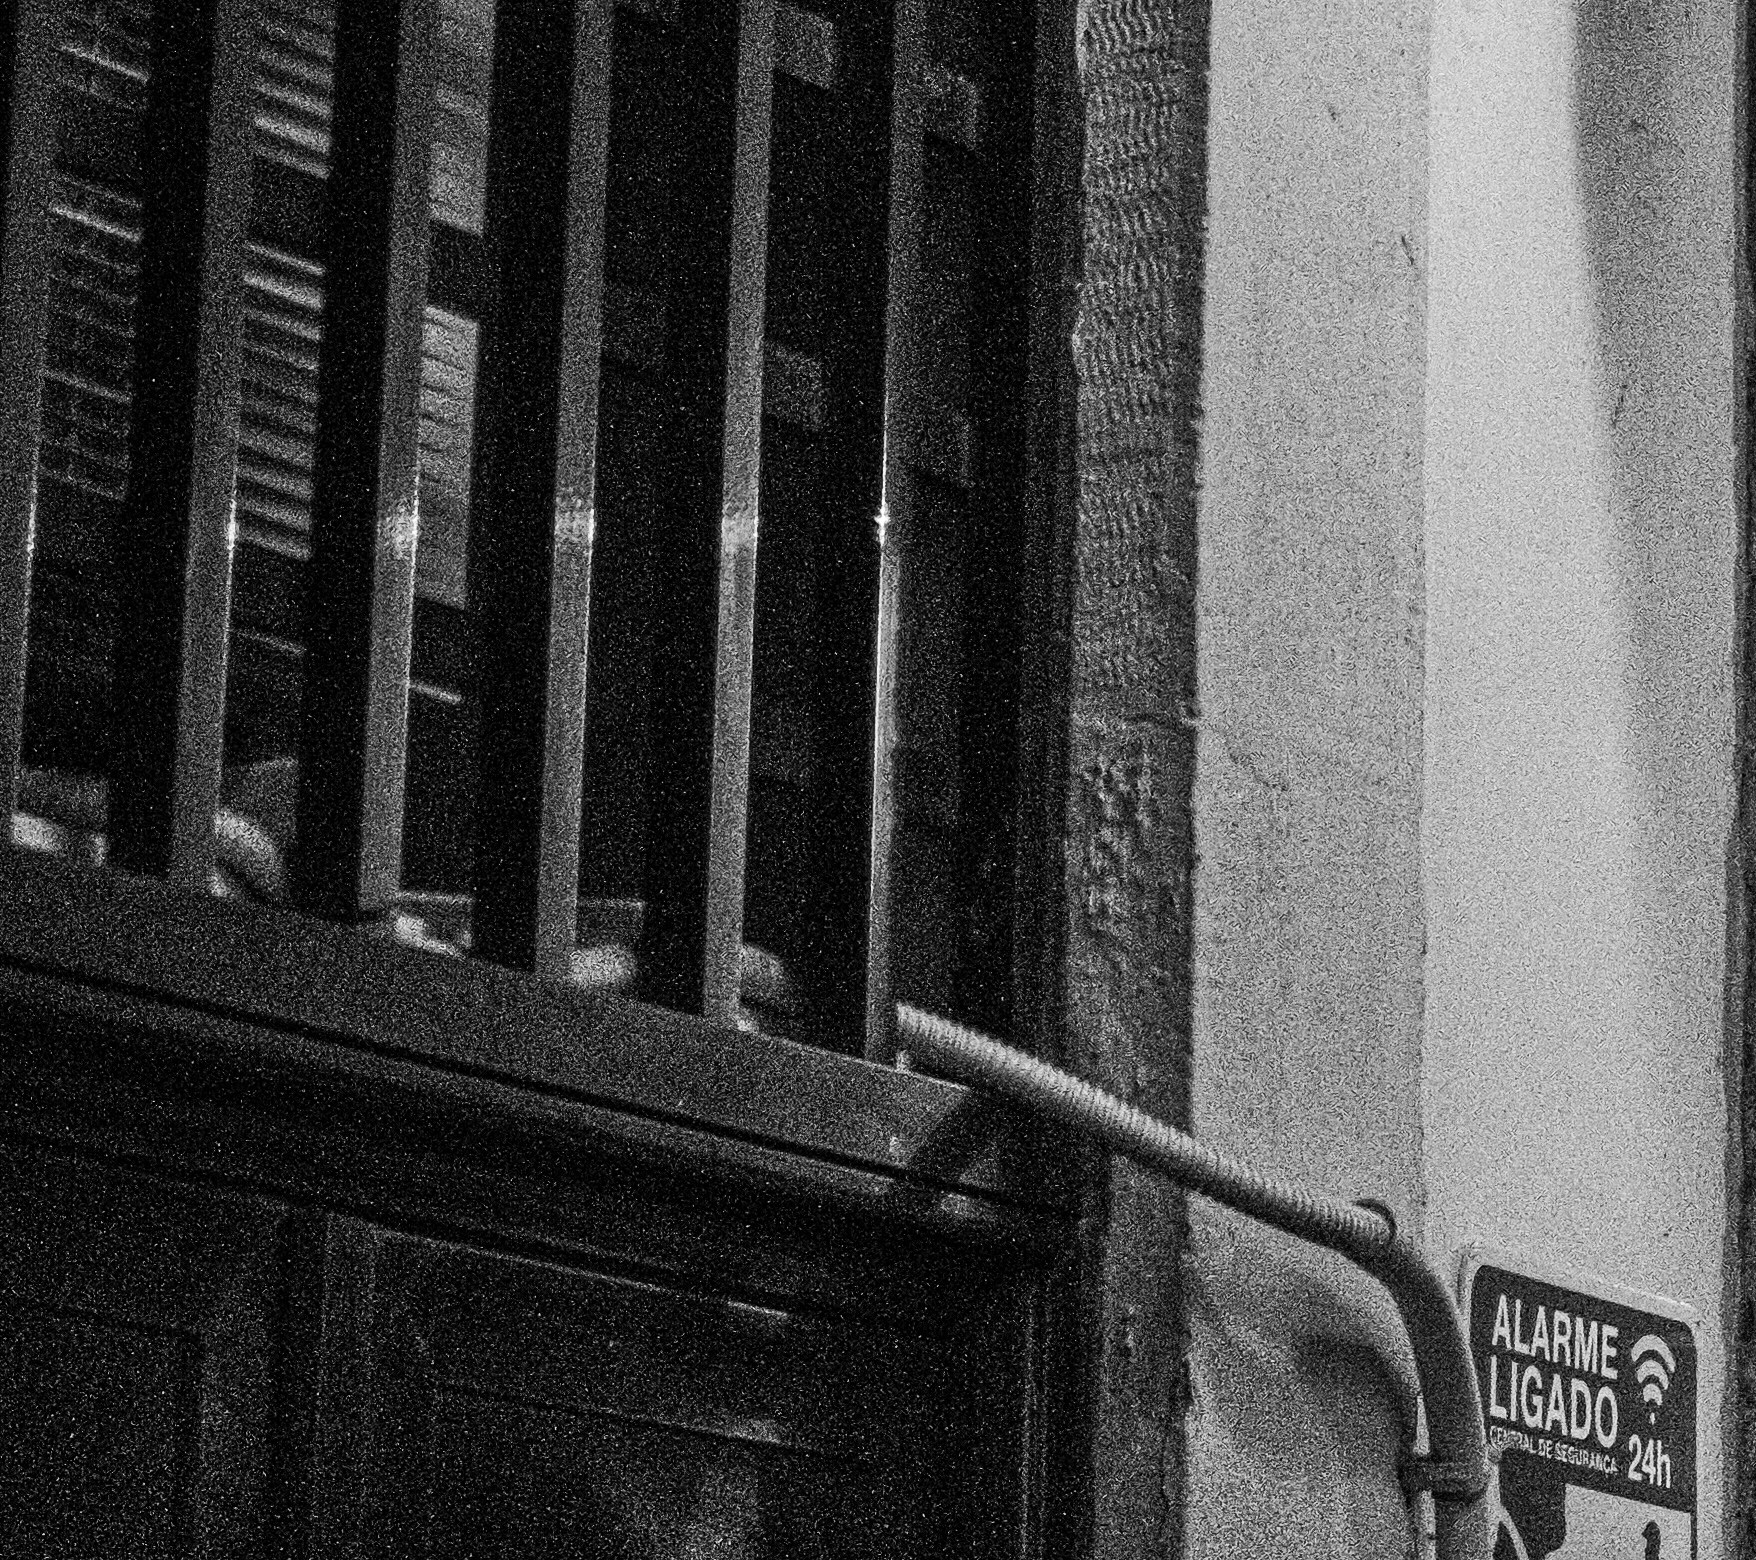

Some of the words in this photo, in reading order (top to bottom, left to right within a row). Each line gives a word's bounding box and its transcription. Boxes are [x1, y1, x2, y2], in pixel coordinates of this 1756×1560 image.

[1492, 1294, 1619, 1380] ALARME
[1489, 1354, 1618, 1448] LIGADO
[1628, 1434, 1671, 1489] 24h
